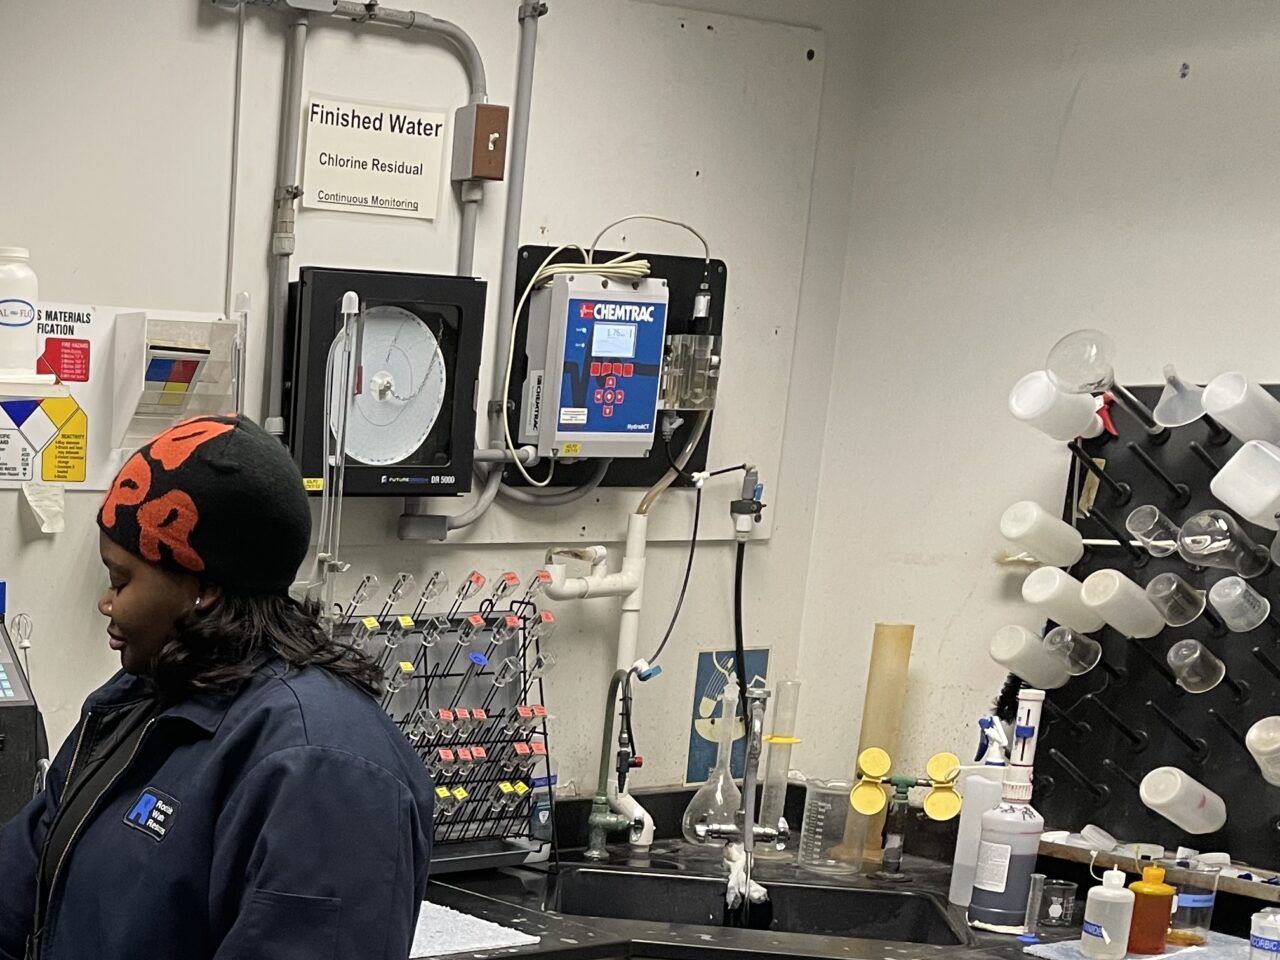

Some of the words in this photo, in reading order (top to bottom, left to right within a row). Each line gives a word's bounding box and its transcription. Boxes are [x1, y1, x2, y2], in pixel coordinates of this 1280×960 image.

[310, 103, 384, 132] Finished
[389, 113, 443, 137] Water
[319, 152, 368, 170] Chlorine
[371, 158, 423, 176] Residual
[317, 190, 369, 205] Continuous
[371, 195, 419, 210] Monitoring
[45, 310, 91, 324] MATERIALS
[593, 304, 655, 322] CHEMTRAC
[36, 323, 75, 335] FICATION
